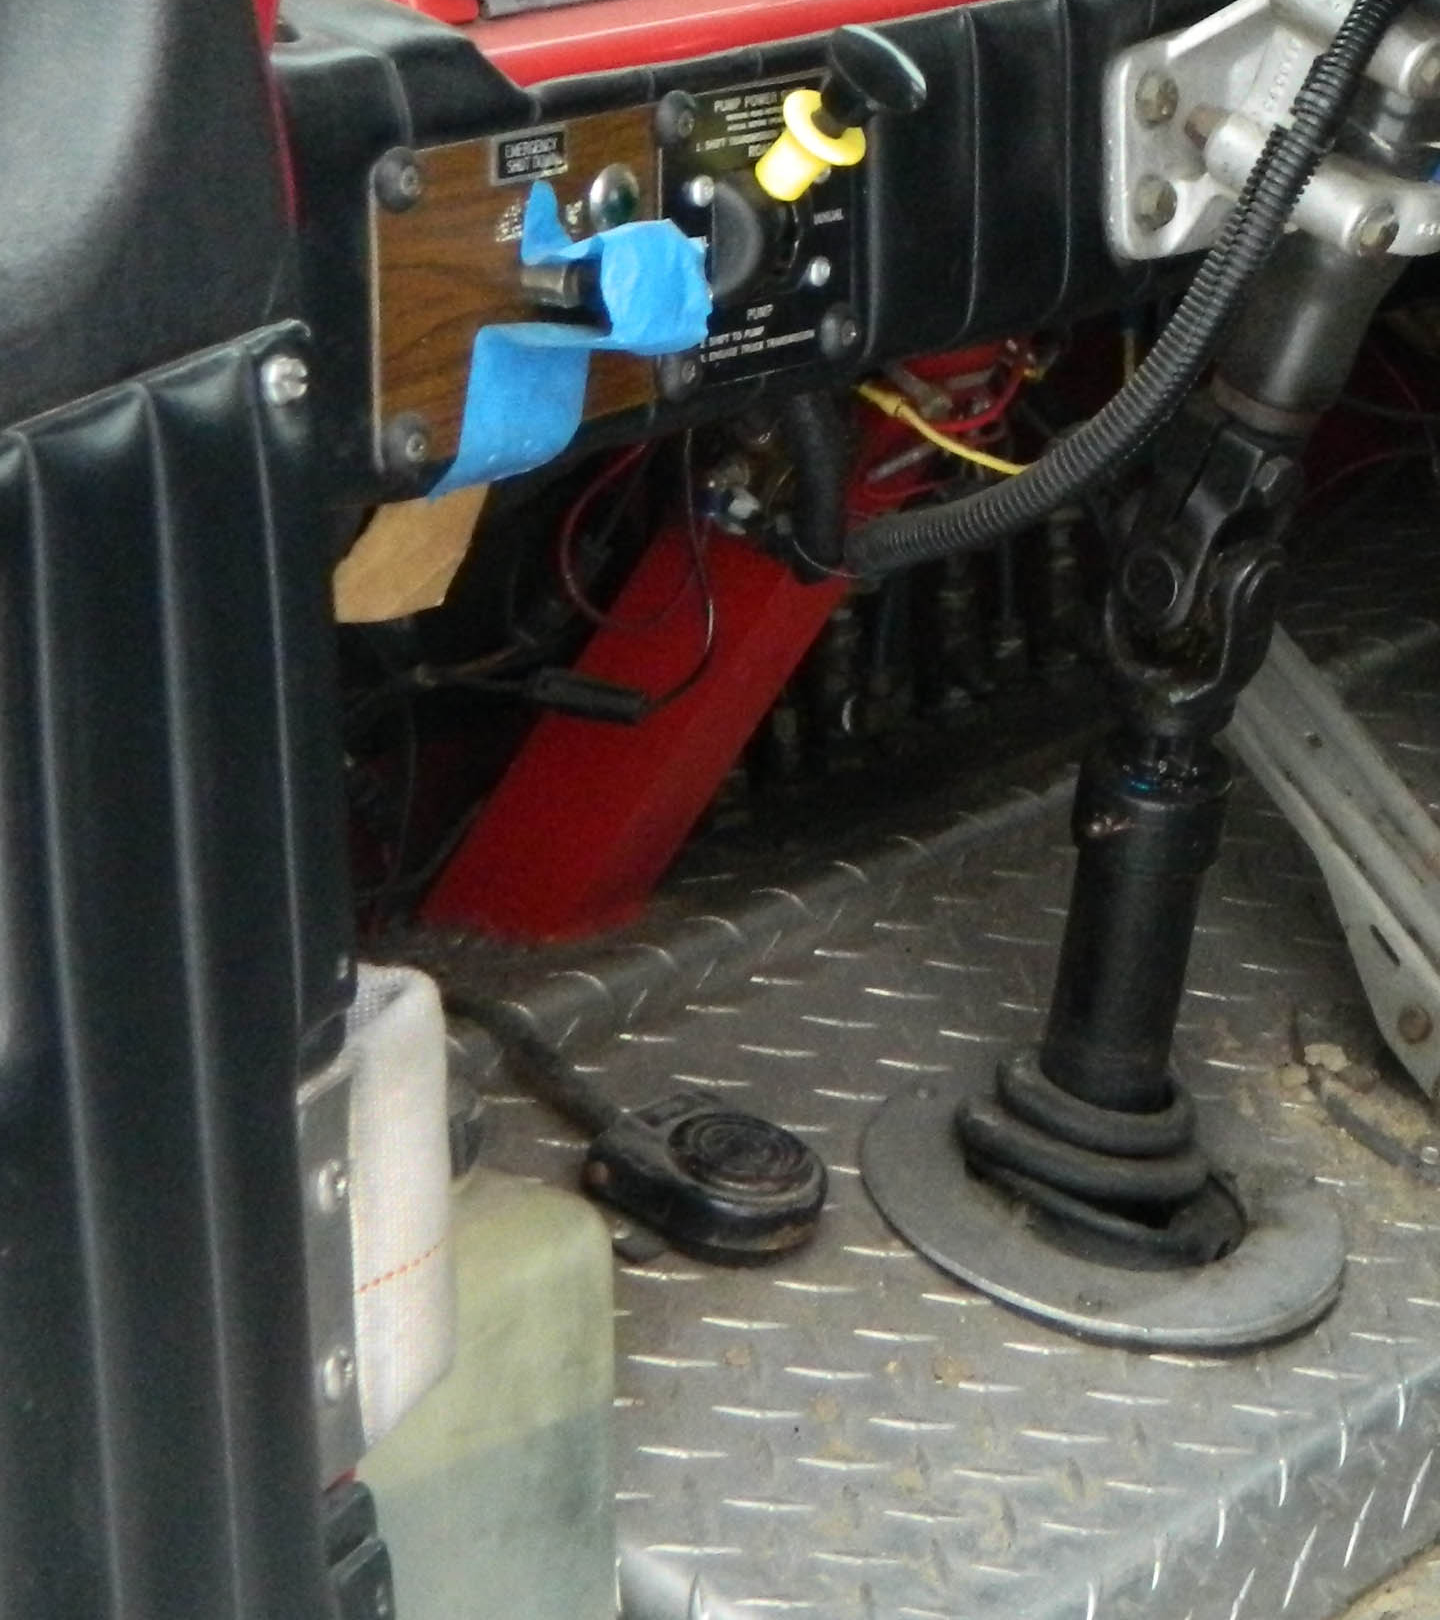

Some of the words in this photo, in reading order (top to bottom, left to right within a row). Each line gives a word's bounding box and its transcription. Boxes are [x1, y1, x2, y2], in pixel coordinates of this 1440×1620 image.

[714, 97, 742, 113] PUMP
[505, 138, 557, 158] EMERGENCY
[746, 303, 774, 321] PUMP
